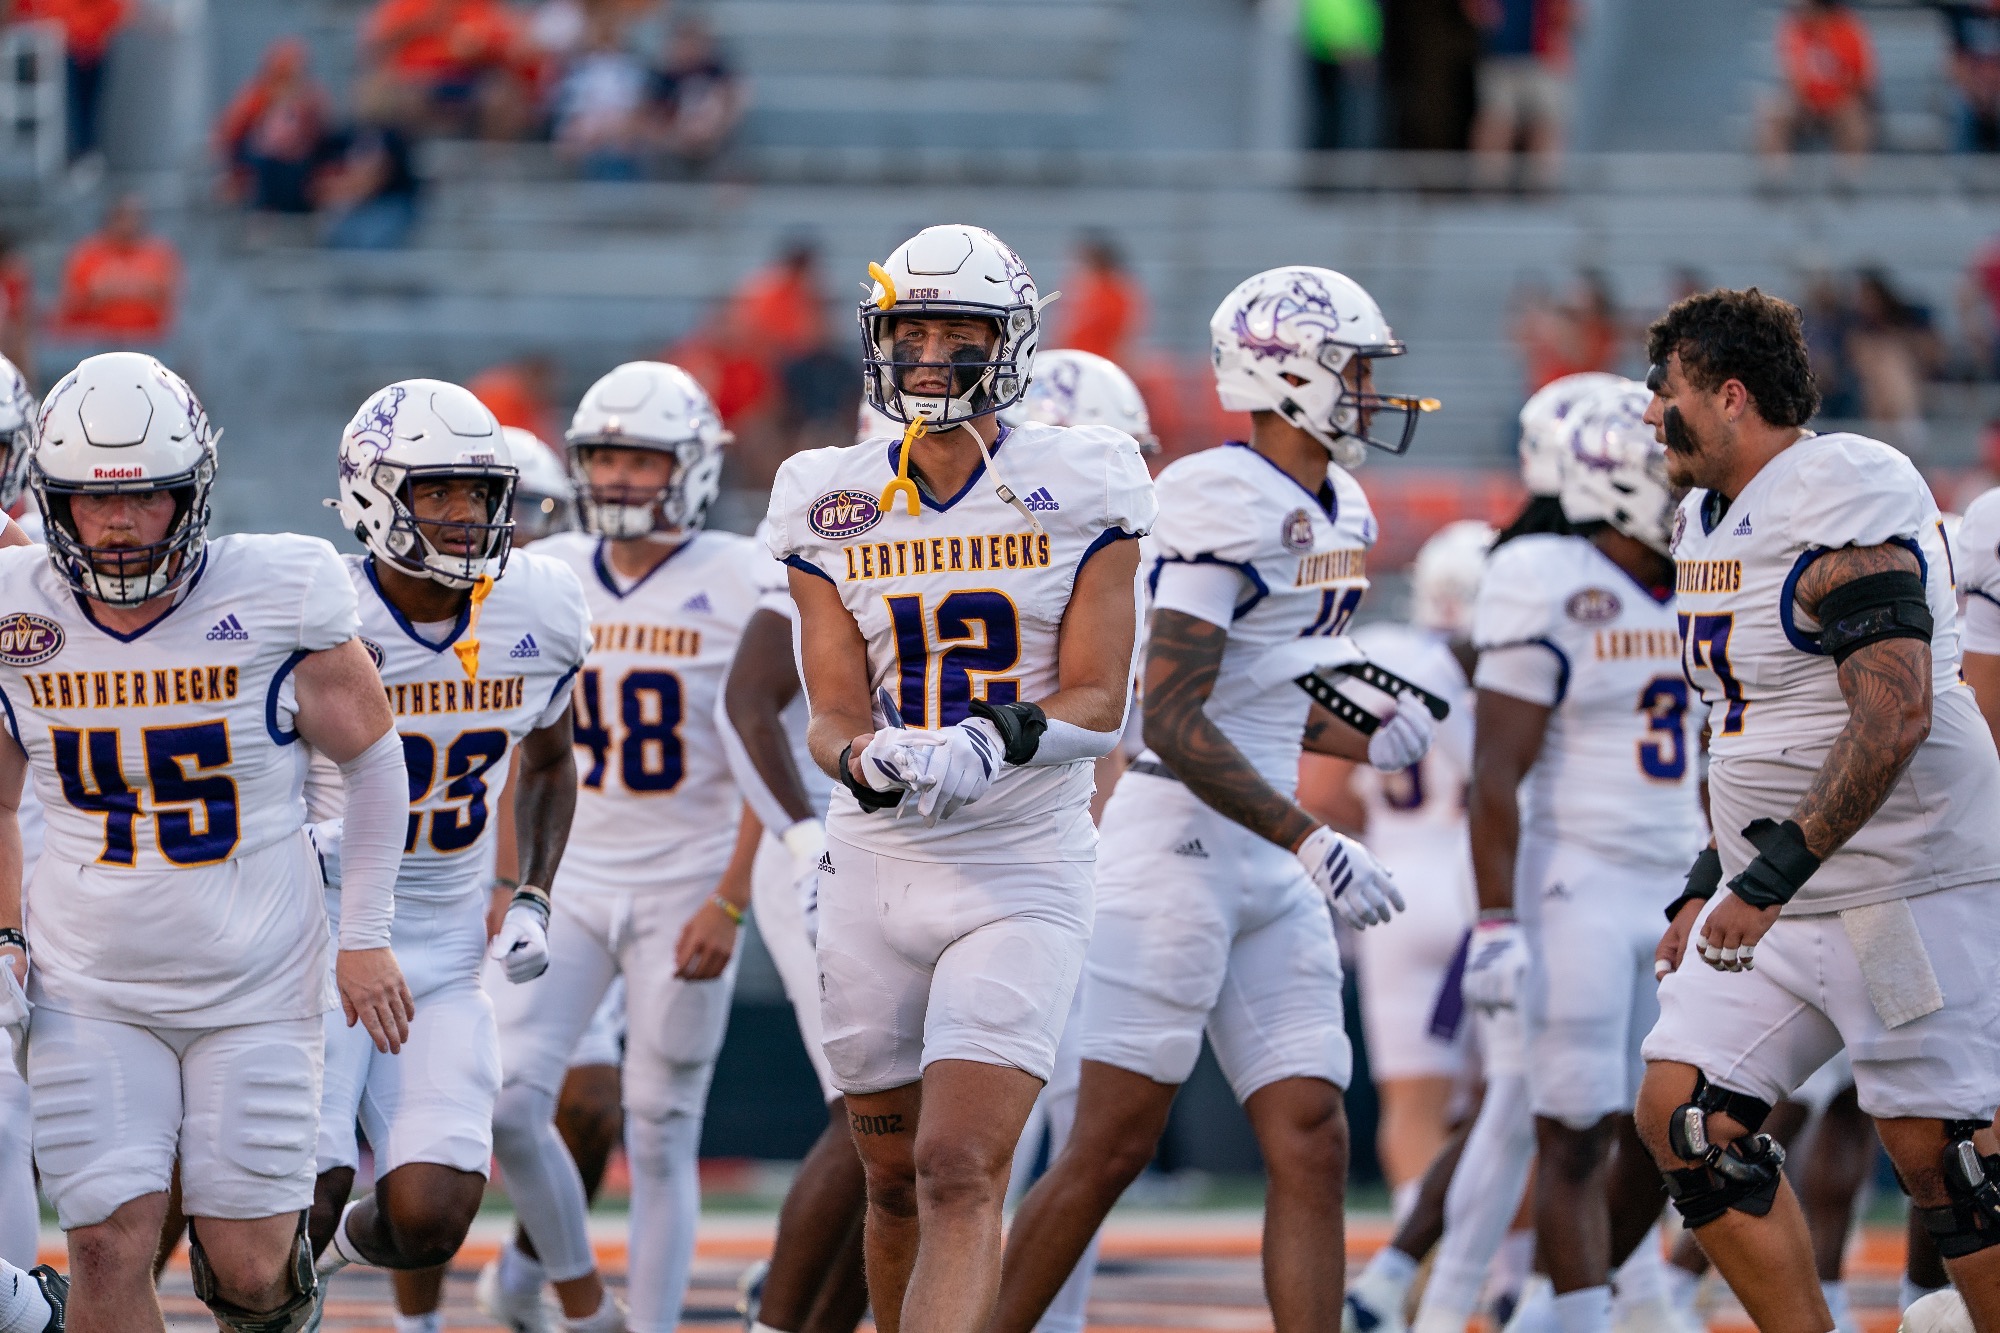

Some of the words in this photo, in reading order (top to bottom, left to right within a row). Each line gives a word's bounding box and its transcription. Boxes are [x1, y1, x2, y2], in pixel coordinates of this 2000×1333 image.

[909, 288, 938, 299] NECKS
[94, 467, 142, 479] Riddell
[821, 503, 866, 528] OVC
[1023, 500, 1060, 512] didas
[843, 532, 1052, 582] LEATHERNECKS
[1, 629, 47, 652] OVC
[206, 629, 249, 641] adidas
[510, 648, 540, 658] adidas
[881, 587, 1022, 731] 12
[23, 665, 239, 710] LEATHERNECKS
[573, 666, 688, 797] 48
[1635, 673, 1692, 784] 3
[47, 717, 242, 869] 45
[850, 1111, 905, 1137] 2002
